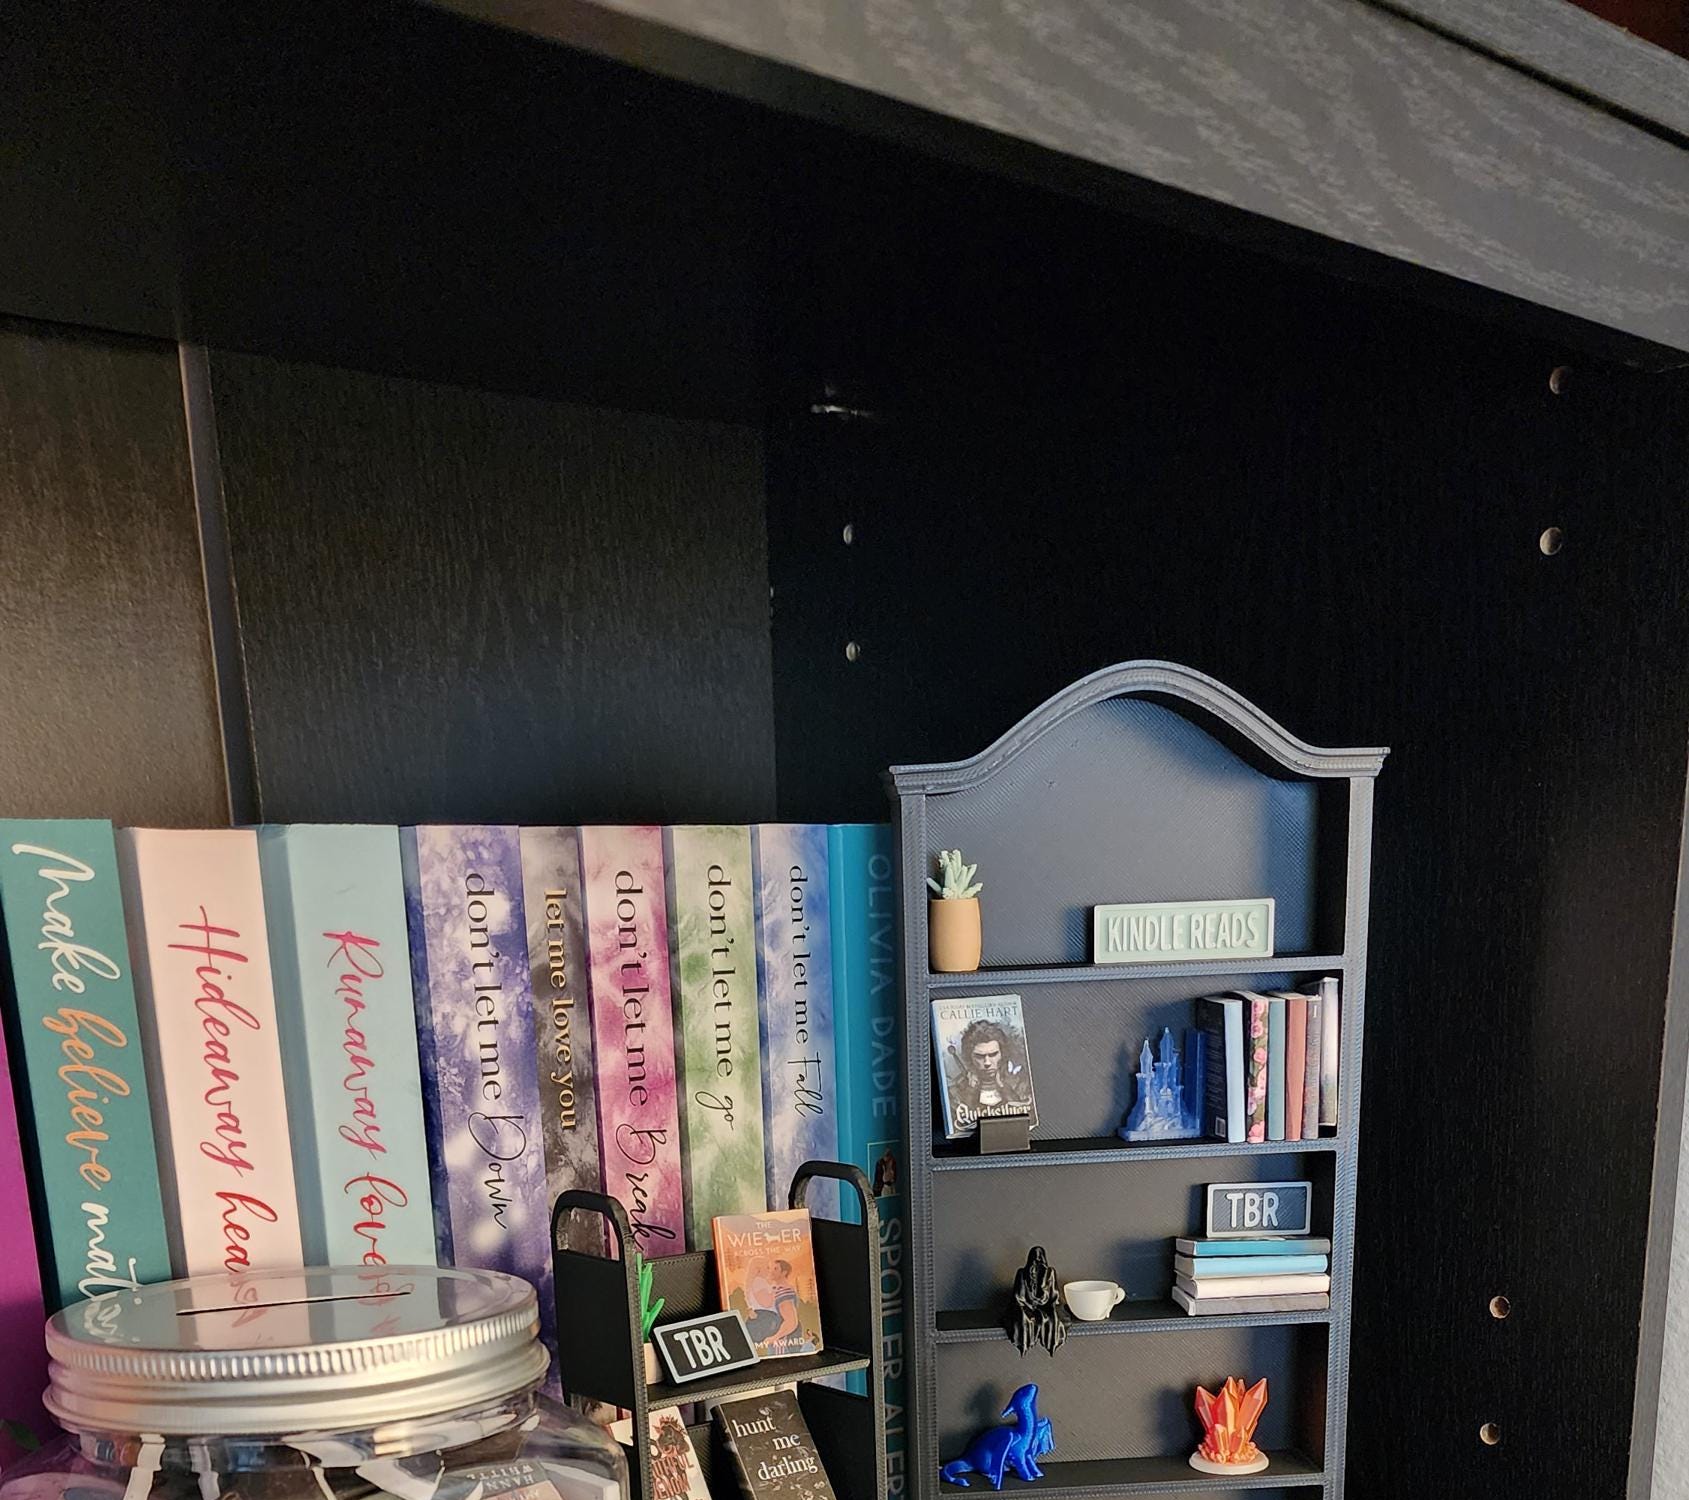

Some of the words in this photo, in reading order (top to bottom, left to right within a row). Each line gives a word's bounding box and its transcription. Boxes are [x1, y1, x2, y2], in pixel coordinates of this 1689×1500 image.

[465, 872, 496, 973] don't
[544, 888, 567, 930] let
[613, 869, 643, 972] don't
[706, 864, 735, 961] don't
[788, 865, 811, 943] don't
[867, 854, 894, 996] OLIVIA
[1105, 912, 1185, 954] KINDLE
[1189, 909, 1261, 950] READS
[545, 937, 566, 990] me
[792, 947, 811, 988] let
[474, 984, 503, 1032] let
[621, 983, 649, 1031] let
[711, 966, 735, 1016] let
[940, 1009, 983, 1020] CALLIE
[986, 1006, 1018, 1018] HART
[549, 997, 574, 1062] love
[794, 992, 810, 1044] me
[322, 930, 388, 1161] Runaway
[479, 1039, 502, 1103] me
[714, 1019, 733, 1080] me
[870, 1015, 896, 1119] DADE
[42, 1007, 131, 1192] believe
[167, 905, 261, 1178] Hideaway
[214, 1190, 279, 1275] hea
[550, 1064, 575, 1130] you
[624, 1039, 647, 1108] me
[787, 1052, 824, 1117] Fall
[694, 1089, 735, 1133] go
[467, 1110, 527, 1230] Down
[615, 1122, 676, 1252] Break
[756, 1221, 772, 1229] THE
[1226, 1192, 1280, 1229] TBR
[77, 1202, 141, 1300] mat
[765, 1247, 780, 1256] THE
[674, 1324, 732, 1370] TBR
[755, 1338, 770, 1350] MY
[772, 1336, 805, 1347] AWARD
[731, 1416, 776, 1437] hunt
[773, 1434, 801, 1450] me
[485, 1474, 534, 1491] HANN
[757, 1456, 818, 1481] darling
